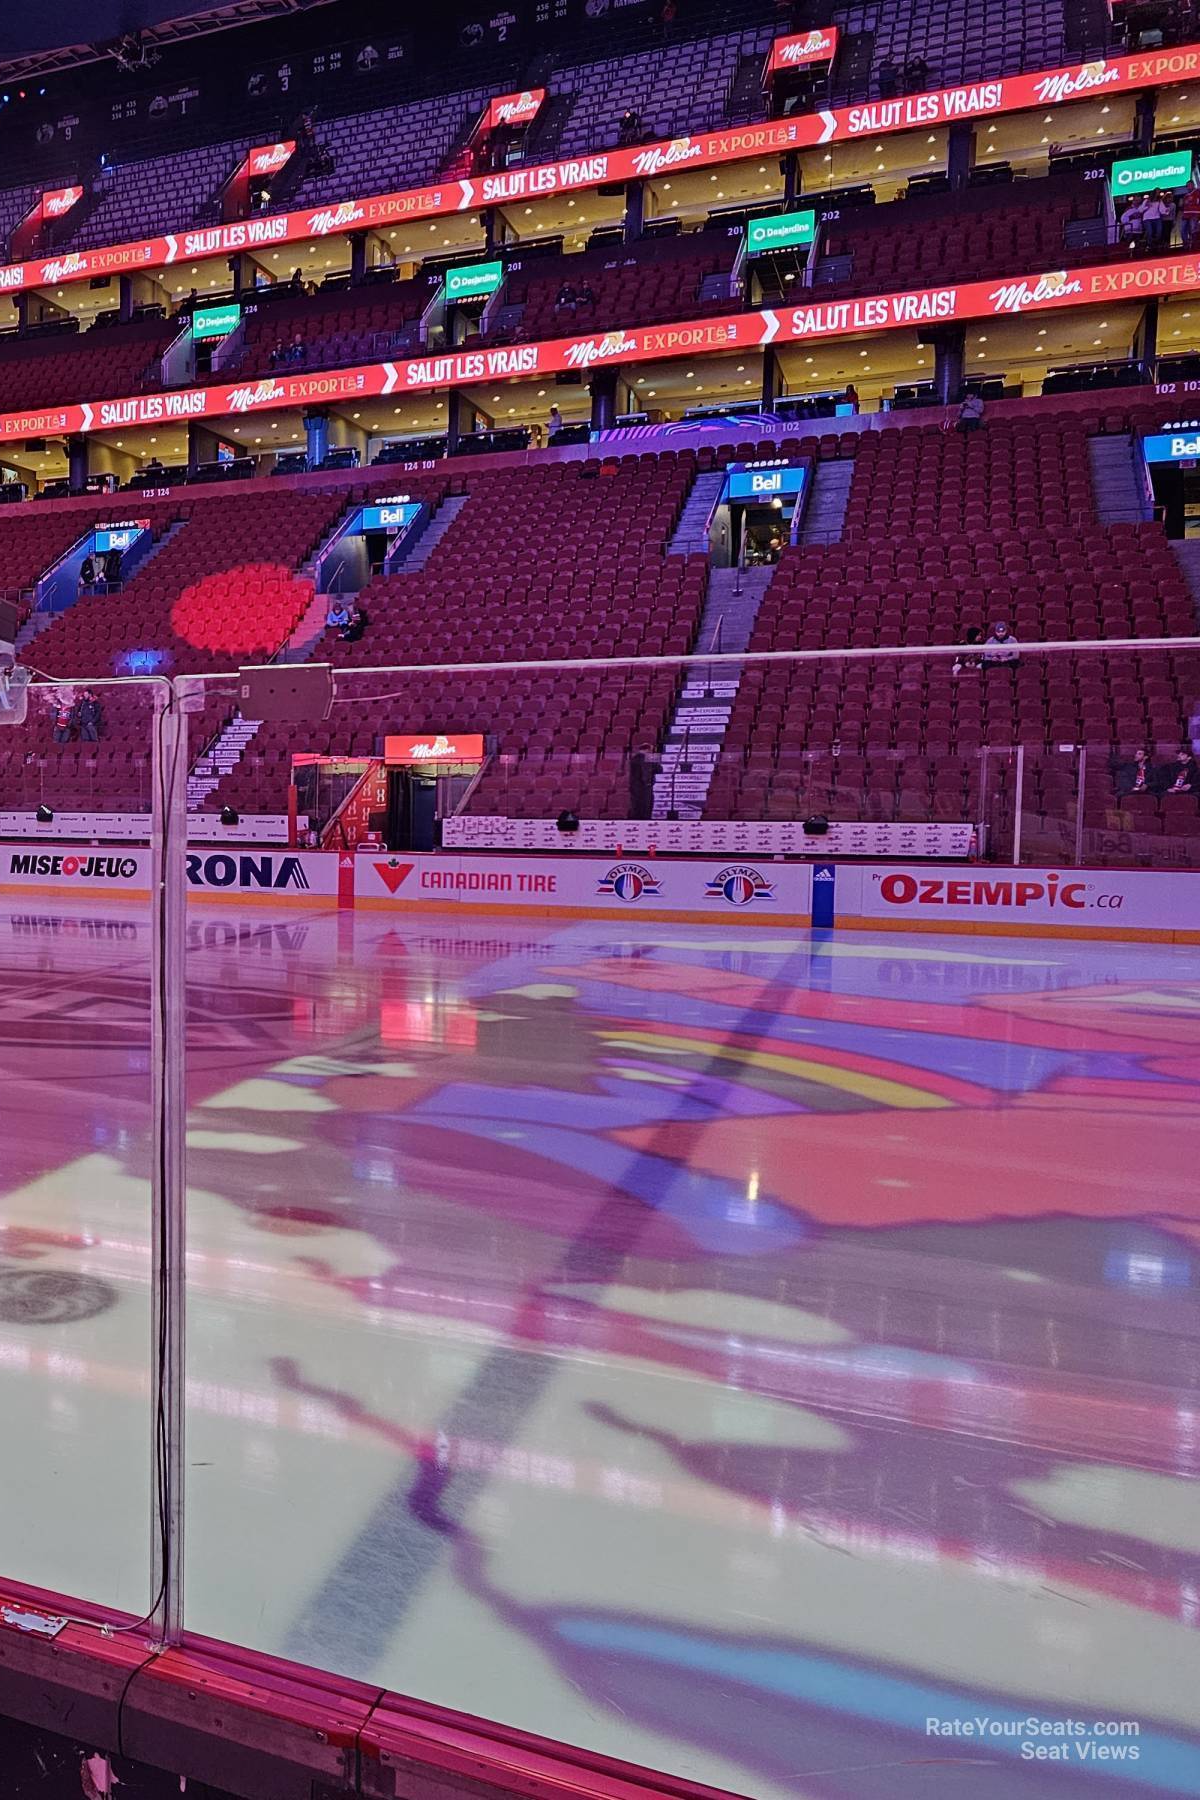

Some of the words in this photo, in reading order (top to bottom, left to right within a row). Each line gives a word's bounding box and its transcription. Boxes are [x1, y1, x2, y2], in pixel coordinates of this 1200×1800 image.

[497, 26, 507, 43] 2
[779, 37, 831, 62] Molson
[1034, 61, 1119, 101] Molson
[1128, 54, 1197, 79] EXPOR
[495, 101, 541, 119] Molson
[849, 102, 903, 132] SALUT
[907, 96, 939, 122] LES
[943, 84, 1002, 115] VRAIS!
[632, 137, 702, 174] Molson
[709, 130, 776, 155] EXPORT
[483, 173, 527, 199] SALUT
[530, 168, 556, 191] LES
[559, 157, 607, 185] VRAIS!
[1084, 169, 1105, 179] 202
[1133, 165, 1186, 181] Desjardins
[307, 202, 364, 234] Molson
[370, 196, 425, 218] EXPORT
[821, 211, 840, 221] 202
[185, 230, 221, 254] SALUT
[223, 226, 245, 247] LES
[248, 218, 287, 242] VRAIS!
[727, 226, 743, 236] 201
[766, 223, 809, 237] Desjardins
[41, 254, 87, 282] Molson
[92, 250, 139, 268] EXPORT
[989, 271, 1082, 312] Molson
[1091, 266, 1182, 292] EXPORT
[792, 304, 850, 334] SALUT
[854, 300, 888, 326] LES
[893, 291, 955, 321] VRAIS!
[564, 331, 637, 367] Molson
[644, 327, 715, 350] EXPORT
[407, 359, 454, 384] SALUT
[457, 355, 484, 378] LES
[487, 348, 537, 374] VRAIS!
[227, 380, 284, 411] Molson
[290, 378, 345, 397] EXPORT
[1154, 383, 1177, 395] 102
[101, 400, 138, 424] SALUT
[140, 398, 162, 419] LES
[165, 392, 205, 415] VRAIS!
[6, 416, 51, 432] EXPORT
[782, 421, 800, 432] 102
[1171, 436, 1200, 456] Bel
[404, 461, 418, 471] 124
[422, 460, 436, 469] 101
[752, 473, 781, 491] Bell
[380, 507, 404, 524] Bell
[409, 743, 456, 758] Molson
[186, 854, 310, 890] RONA
[421, 871, 513, 891] CANADIAN
[517, 874, 557, 892] TIRE
[609, 864, 652, 880] OLYMEL
[718, 867, 761, 883] OLYMEL
[1089, 893, 1124, 909] .ca
